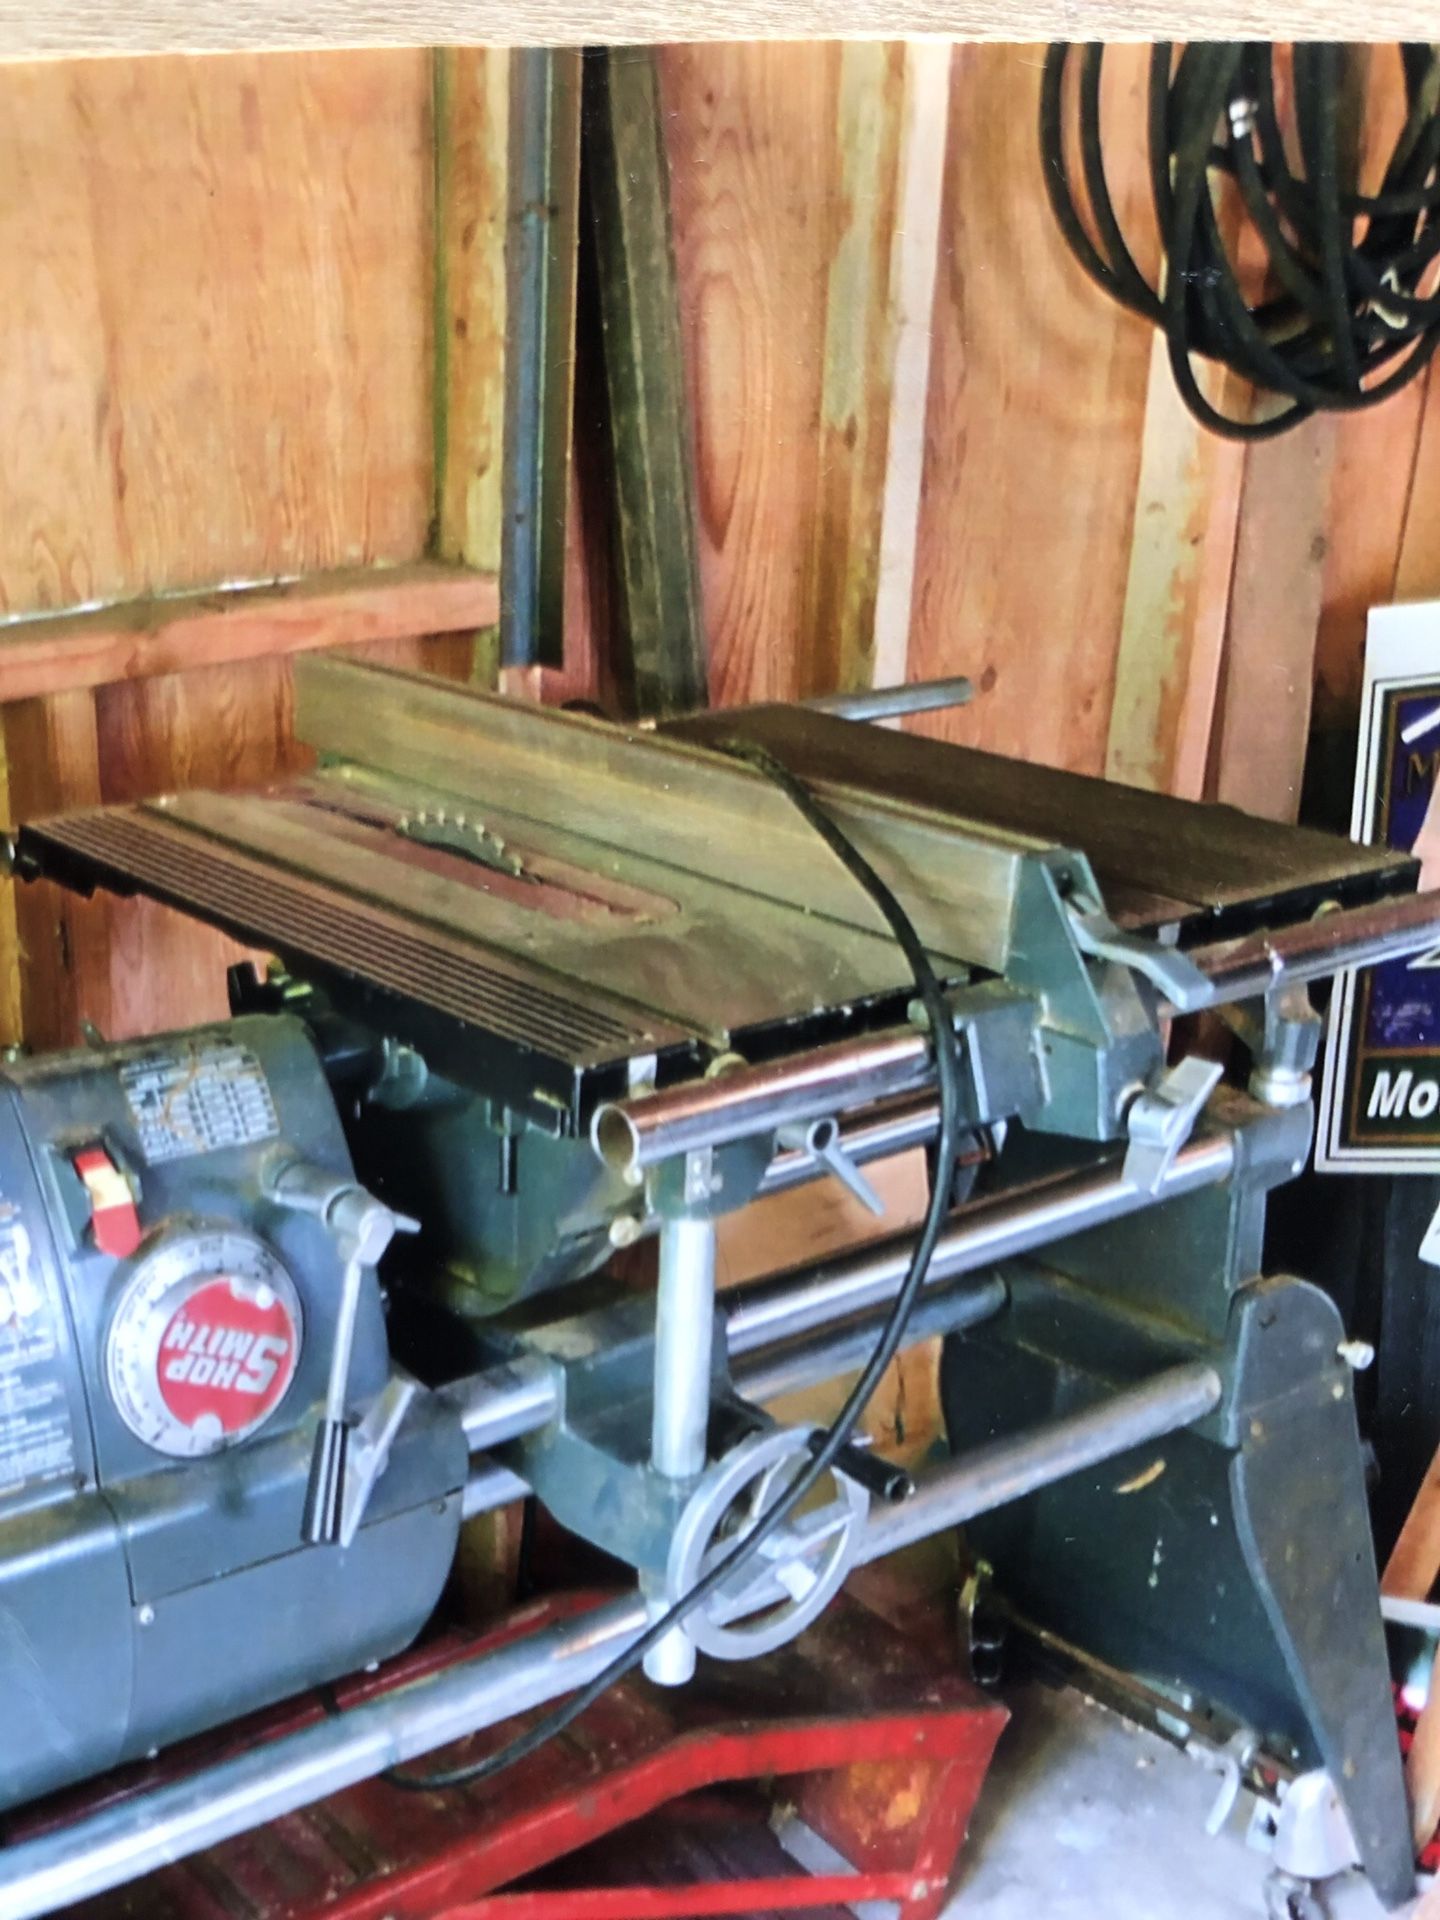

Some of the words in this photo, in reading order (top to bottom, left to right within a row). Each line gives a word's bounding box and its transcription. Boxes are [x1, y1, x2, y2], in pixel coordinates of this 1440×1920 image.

[1367, 1070, 1440, 1118] Mo
[163, 1319, 289, 1380] SMITH
[164, 1339, 288, 1394] SHOP
